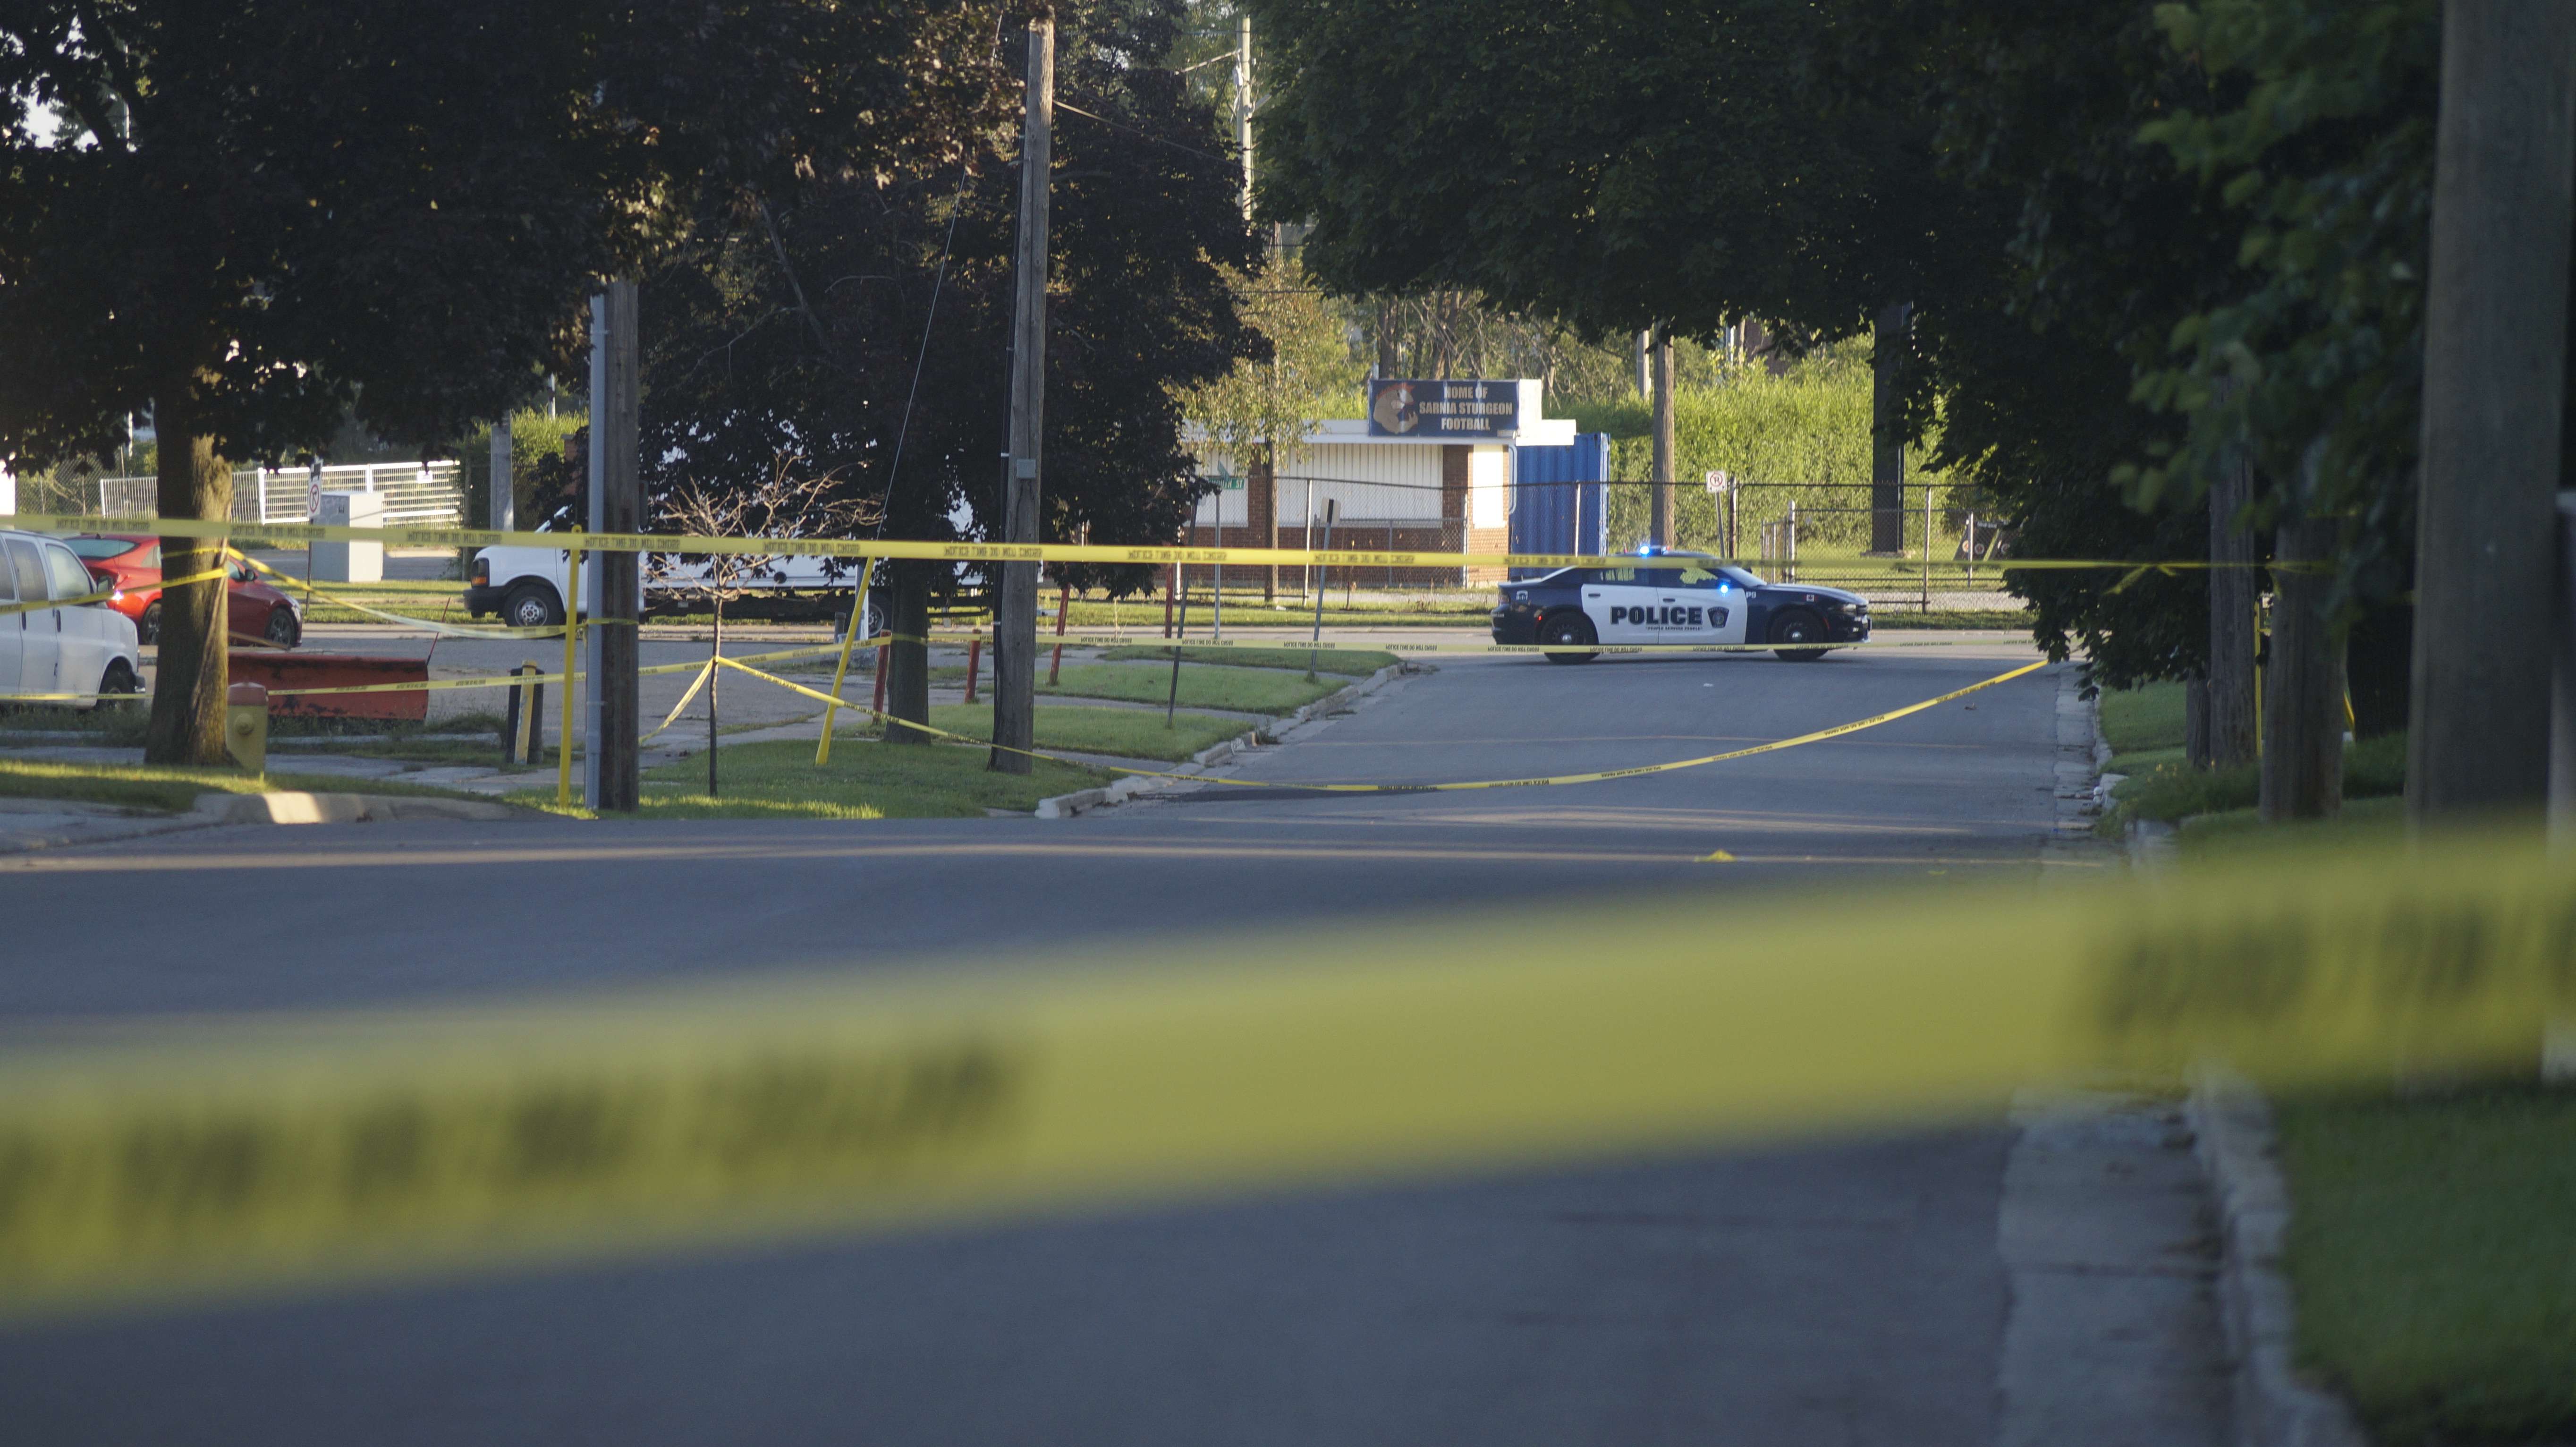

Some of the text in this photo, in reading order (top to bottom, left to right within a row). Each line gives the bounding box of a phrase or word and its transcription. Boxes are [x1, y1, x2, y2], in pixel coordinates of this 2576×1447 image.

[1444, 386, 1488, 399] HOME OF
[1419, 401, 1513, 415] SARNIA STURGEON
[1441, 417, 1491, 430] FOOTBALL
[1610, 606, 1703, 625] POLICE
